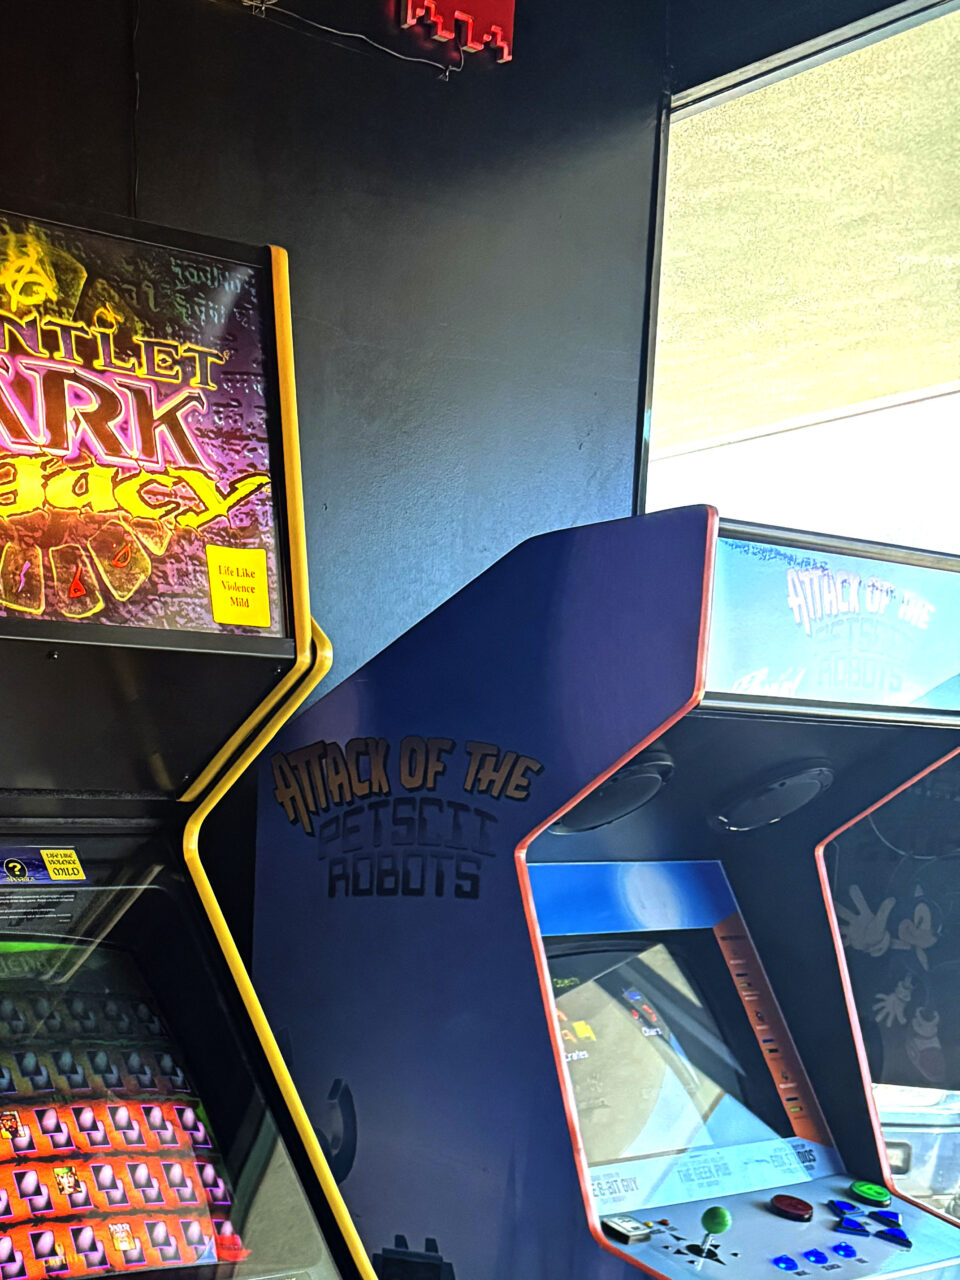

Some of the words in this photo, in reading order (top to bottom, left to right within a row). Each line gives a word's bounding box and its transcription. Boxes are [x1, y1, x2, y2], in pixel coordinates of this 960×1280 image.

[218, 564, 235, 578] Life
[236, 567, 256, 579] Like
[221, 580, 256, 594] Violence
[230, 595, 250, 608] Mild
[786, 567, 862, 637] ATTACK
[270, 737, 392, 837] ATTACK
[399, 735, 456, 792] OF
[464, 740, 546, 801] THE
[327, 852, 482, 900] ROBOTS
